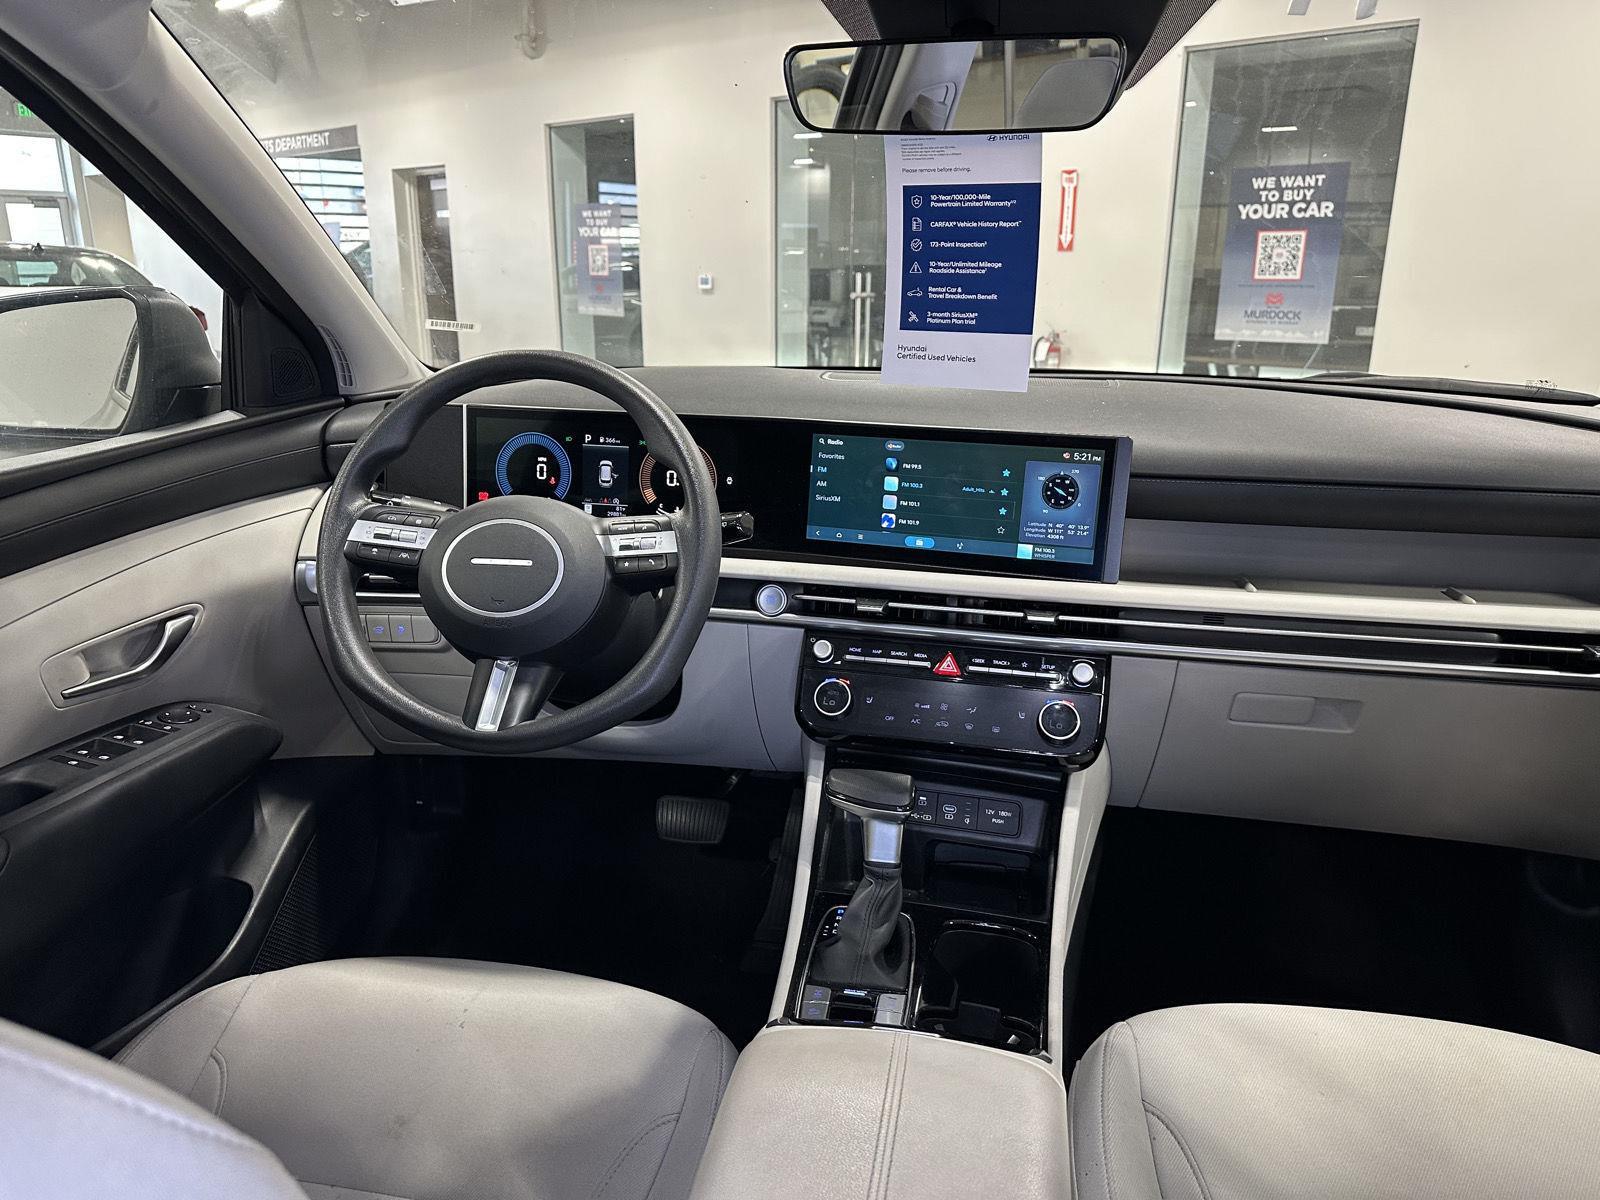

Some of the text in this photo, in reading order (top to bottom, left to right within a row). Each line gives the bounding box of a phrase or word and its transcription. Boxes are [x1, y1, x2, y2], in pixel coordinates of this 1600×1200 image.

[275, 132, 330, 152] DEPARTMENT
[1252, 174, 1326, 190] WE WANT
[1260, 189, 1315, 202] TO BUY
[1238, 202, 1334, 219] YOUR CAR
[578, 227, 599, 237] YOUR
[1244, 310, 1301, 320] MURDOCK
[898, 344, 927, 353] Hyundai
[897, 352, 927, 361] Certified
[946, 354, 976, 363] Vehicles
[585, 434, 592, 443] P
[819, 452, 845, 460] Favorites
[1073, 452, 1091, 461] 5:21
[536, 464, 547, 479] 0
